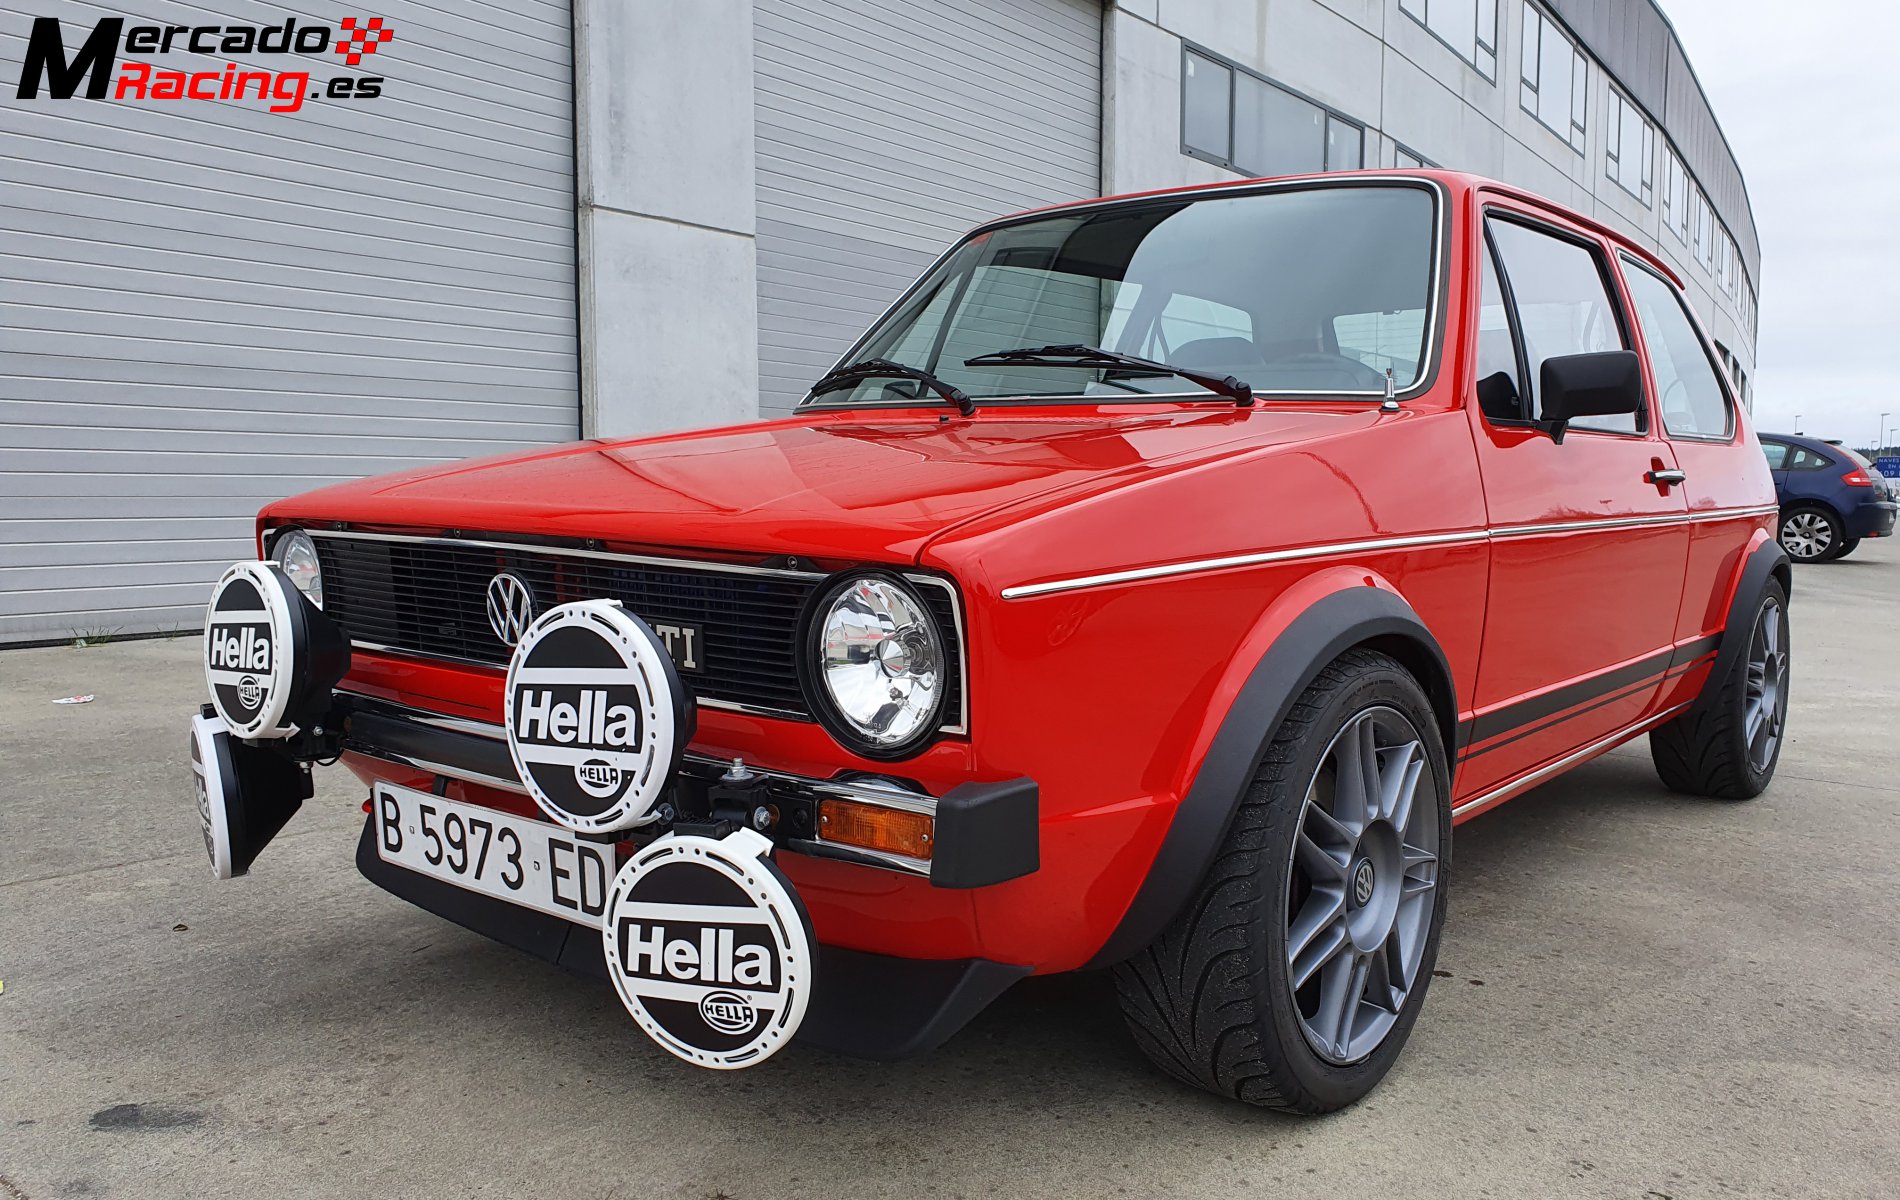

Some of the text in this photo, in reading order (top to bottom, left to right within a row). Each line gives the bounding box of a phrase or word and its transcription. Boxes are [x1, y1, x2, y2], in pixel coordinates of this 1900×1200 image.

[211, 626, 270, 670] Hella
[648, 623, 696, 669] TI
[240, 686, 260, 701] HELLA
[518, 689, 636, 747] Hella
[579, 766, 619, 785] HELLA
[380, 791, 607, 917] B 5973 ED
[627, 923, 773, 986] Hella
[704, 1003, 754, 1023] HELLA
